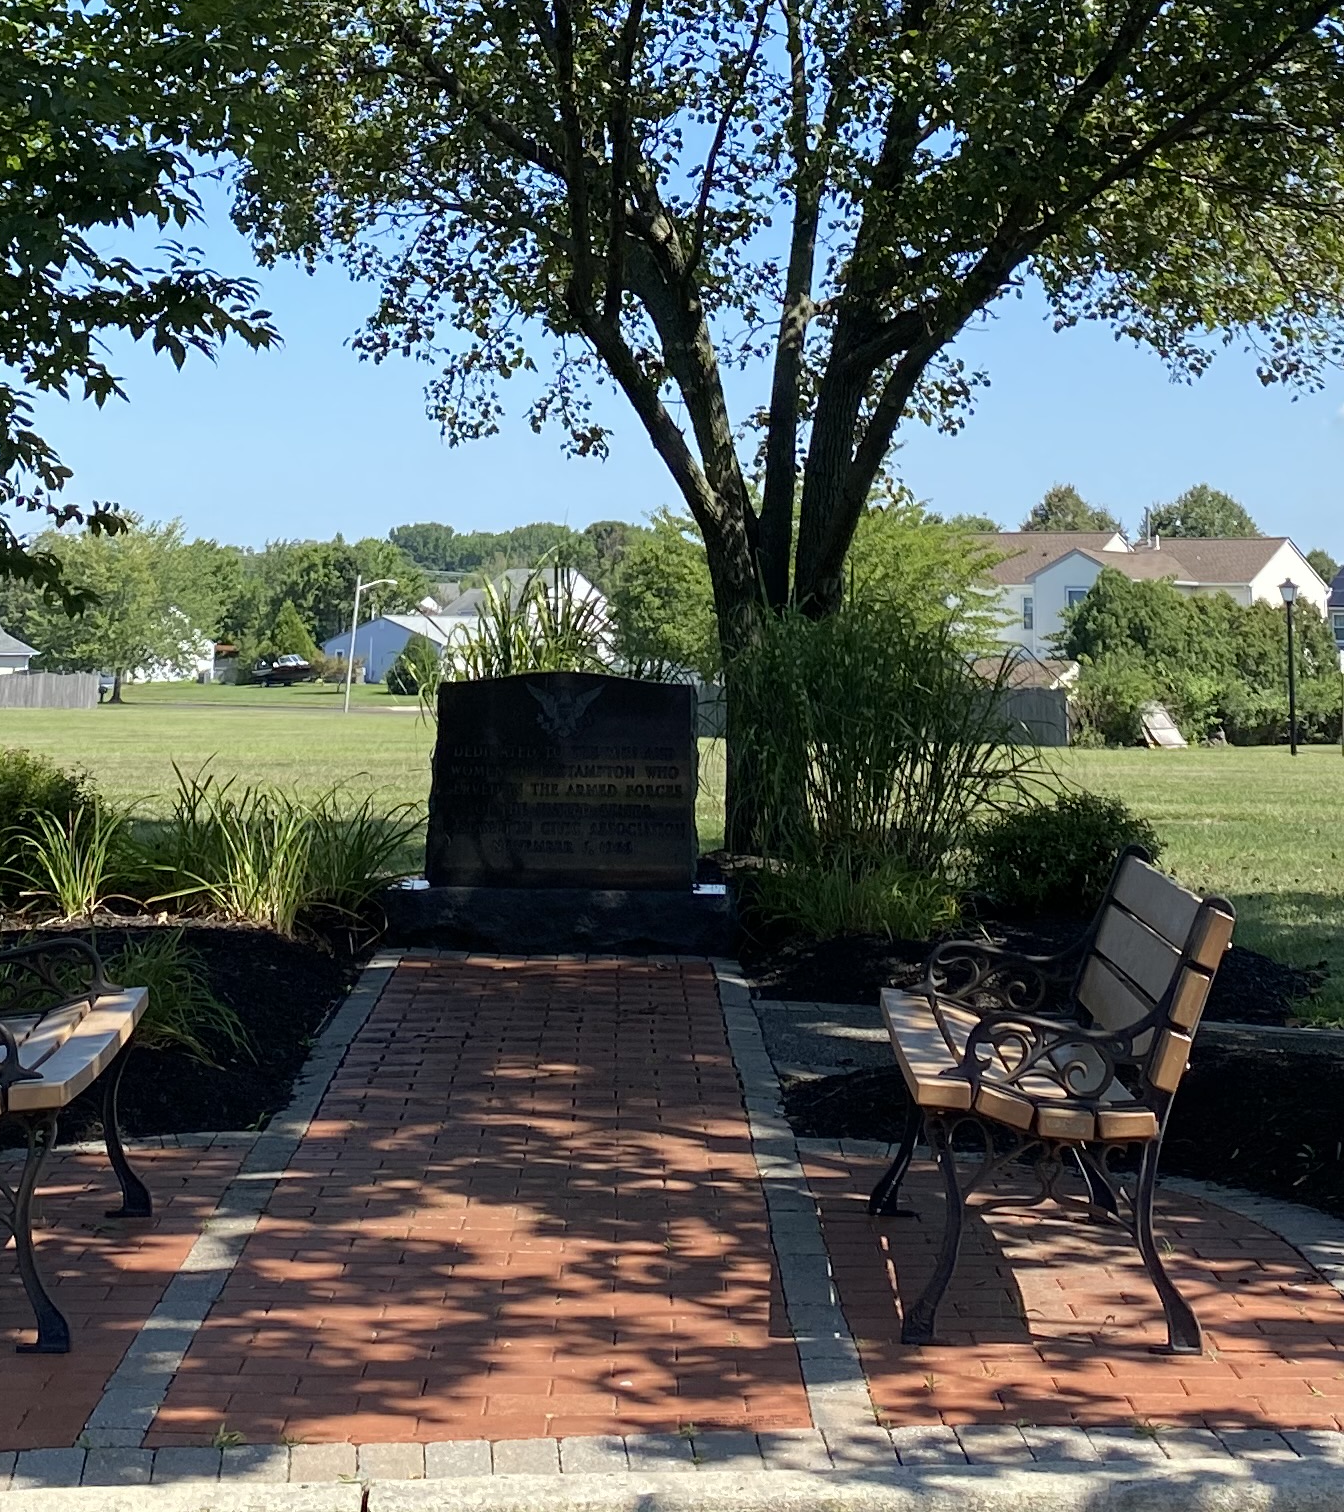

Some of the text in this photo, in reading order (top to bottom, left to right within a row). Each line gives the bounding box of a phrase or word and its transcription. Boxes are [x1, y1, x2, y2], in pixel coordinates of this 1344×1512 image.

[645, 765, 680, 779] WHO
[530, 782, 559, 797] THE
[566, 783, 618, 798] ARMED
[626, 783, 684, 798] FORCES
